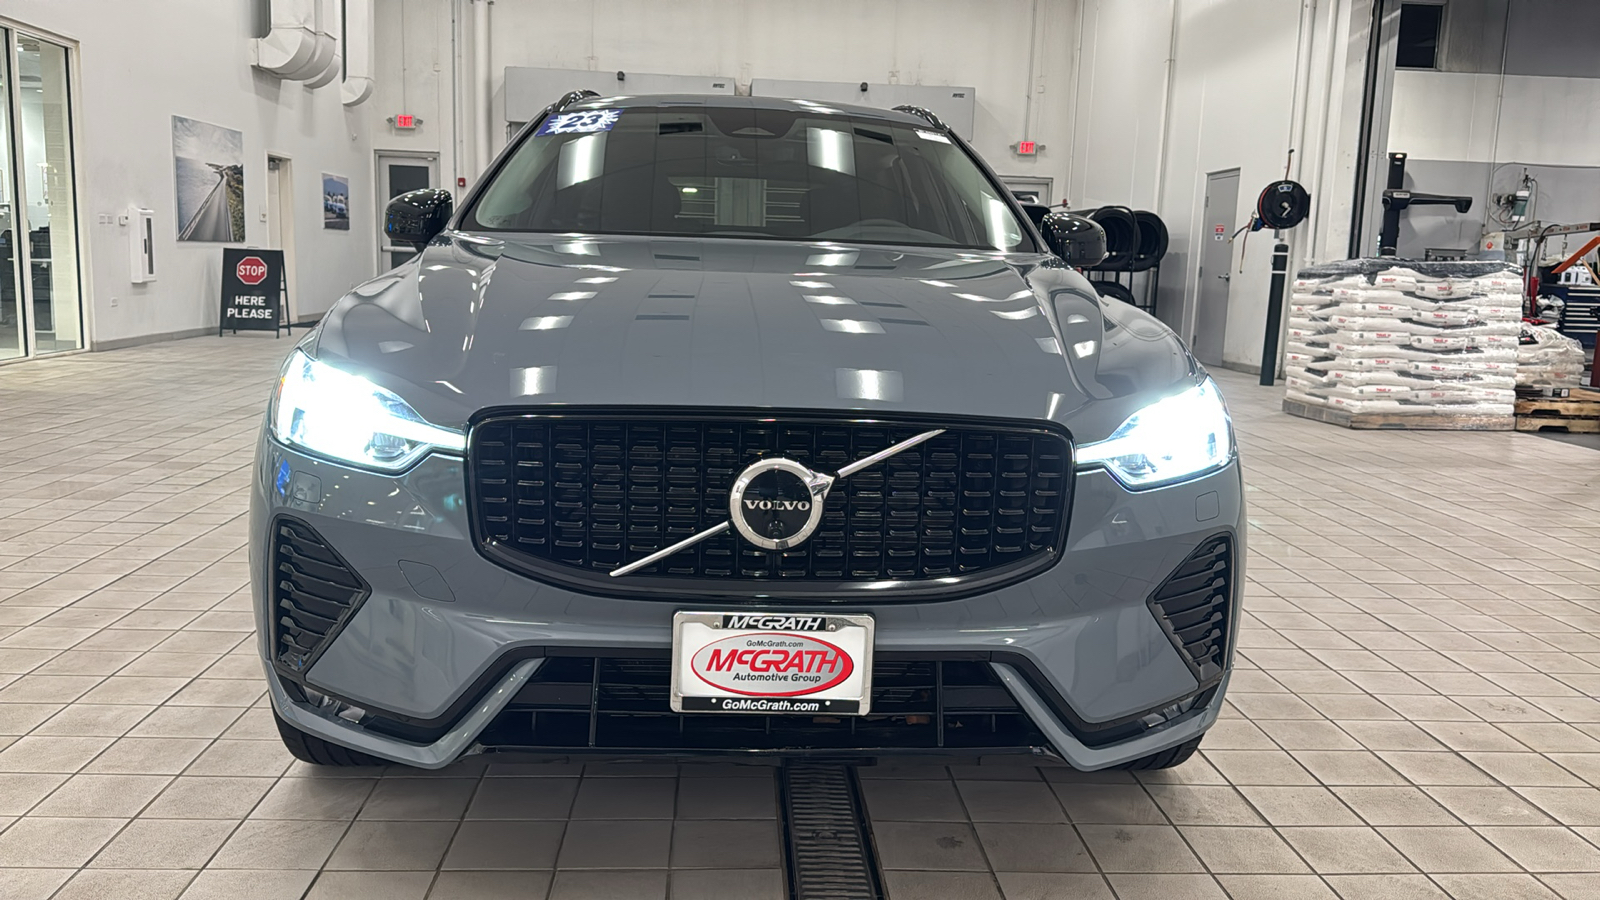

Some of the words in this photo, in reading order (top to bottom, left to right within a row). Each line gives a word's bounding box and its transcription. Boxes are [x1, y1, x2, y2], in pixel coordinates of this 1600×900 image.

[398, 115, 413, 127] EXIT
[560, 114, 603, 128] 23
[1020, 141, 1035, 153] EXIT
[239, 265, 265, 276] STOP
[235, 295, 266, 306] HERE
[227, 308, 273, 319] PLEASE
[743, 500, 810, 511] VOLVO
[746, 639, 804, 648] GoMcGrath.com
[732, 672, 789, 682] Automotive
[791, 673, 822, 684] Group
[722, 699, 820, 712] GoMcGrath.com
